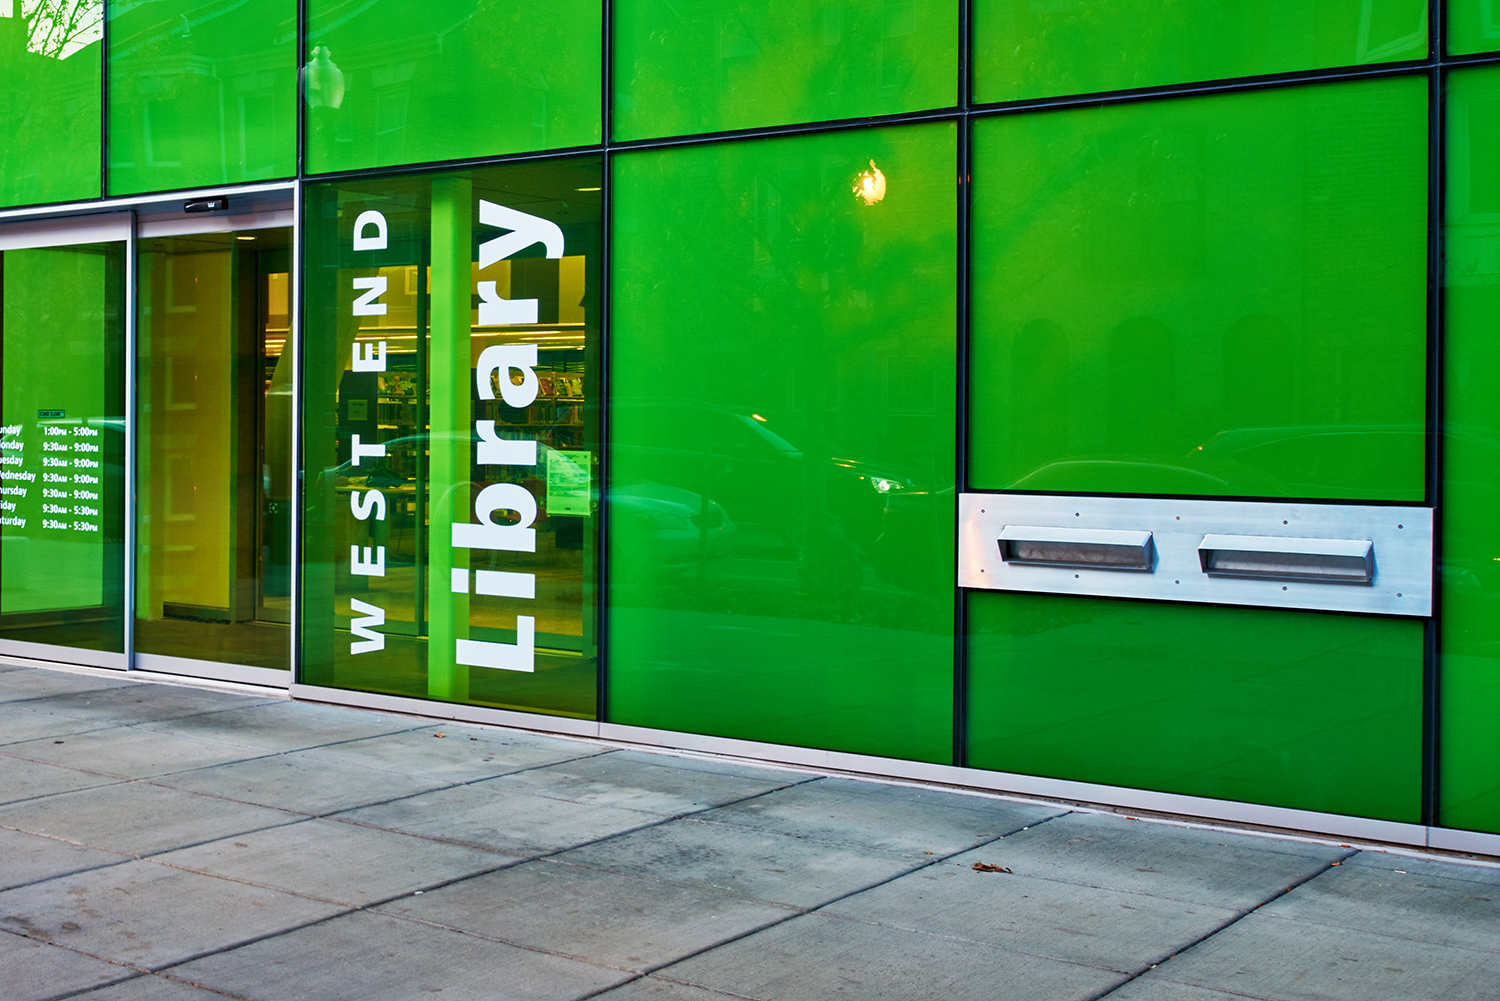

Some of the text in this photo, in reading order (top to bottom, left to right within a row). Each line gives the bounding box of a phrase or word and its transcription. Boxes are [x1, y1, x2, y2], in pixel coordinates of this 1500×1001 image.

[44, 427, 67, 435] 1:00PM
[74, 427, 97, 436] 5:00PM
[351, 210, 388, 655] WEST END
[452, 200, 563, 672] Library
[43, 442, 67, 451] 9:30AM
[74, 443, 98, 452] 9:00PM
[43, 457, 67, 467] 9:30AM
[74, 458, 98, 468] 9:00PM
[43, 473, 67, 482] 9:30AM
[74, 474, 98, 483] 9:00PM
[43, 488, 67, 498] 9:30AM
[74, 490, 98, 499] 9:00PM
[43, 504, 67, 513] 9:30AM
[74, 506, 98, 515] 5:30PM
[43, 519, 67, 529] 9:30AM
[74, 521, 97, 531] 5:30PM
